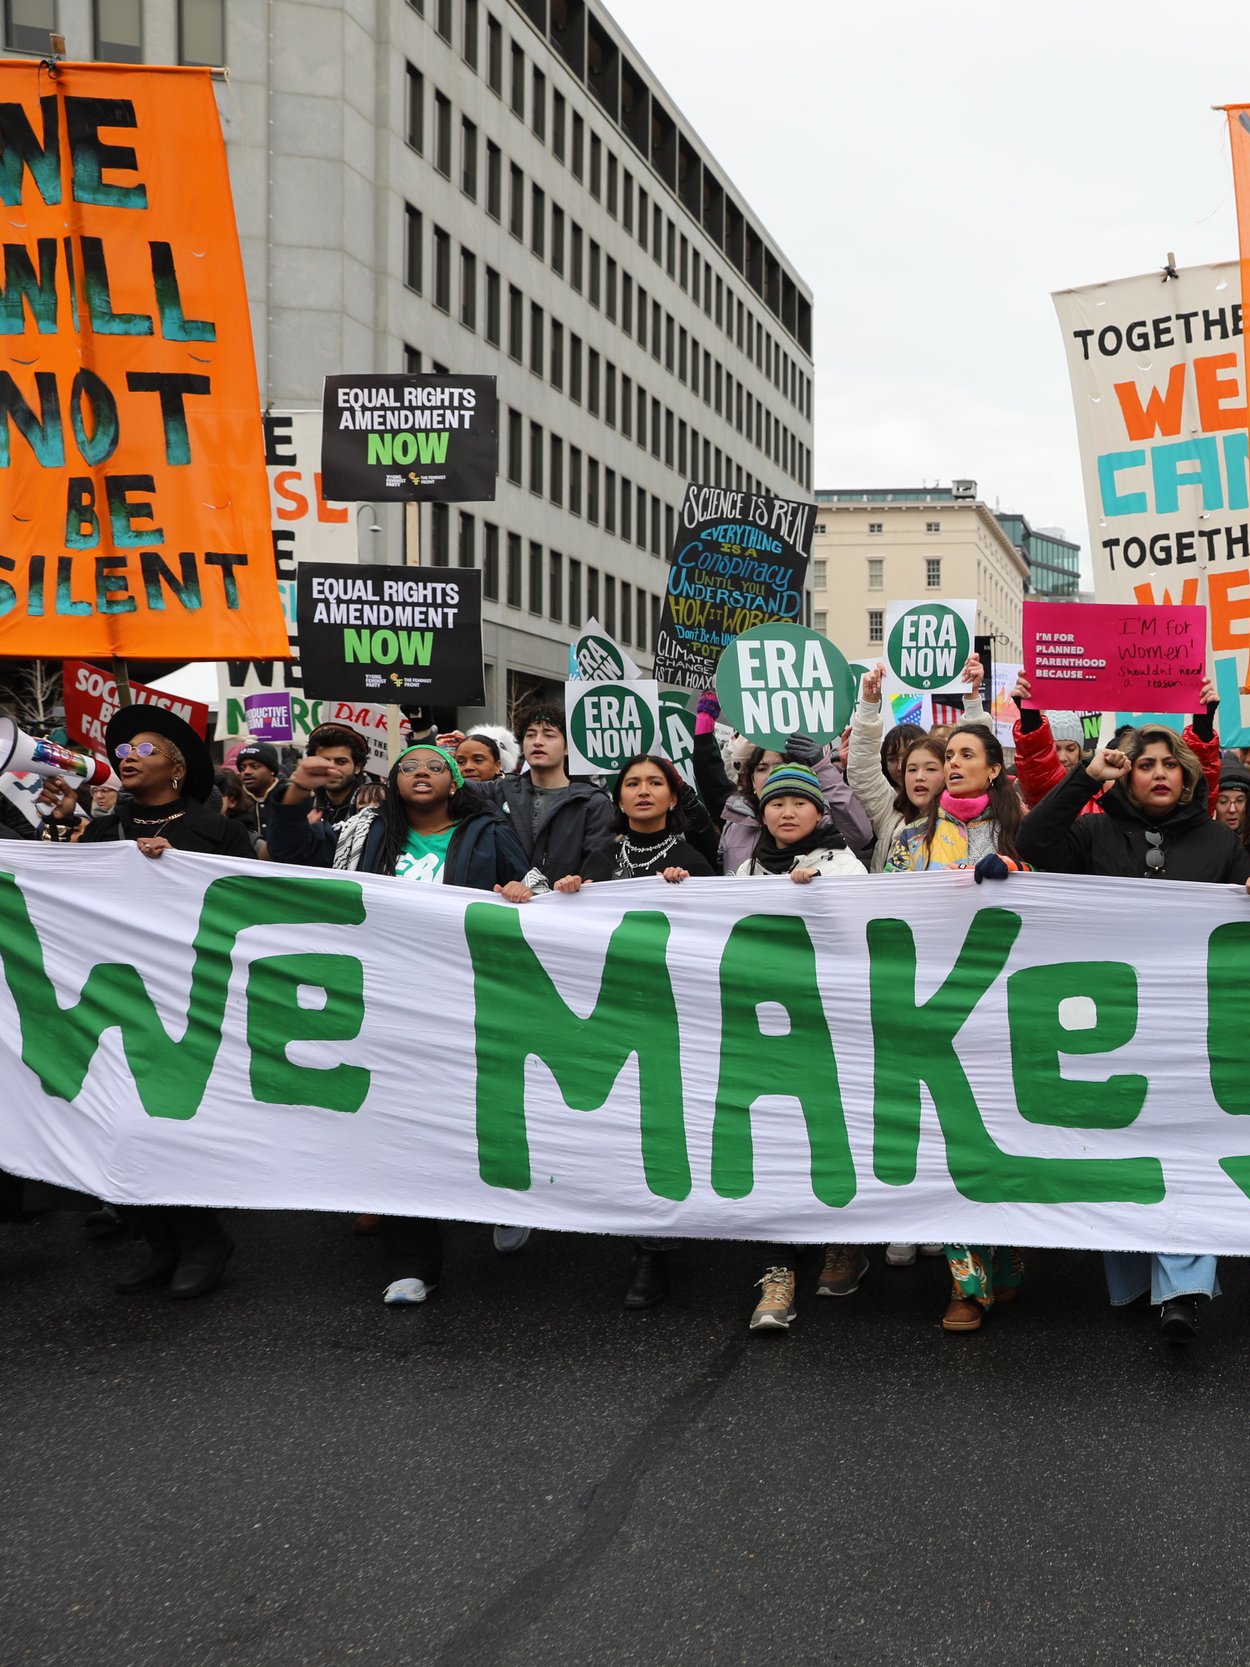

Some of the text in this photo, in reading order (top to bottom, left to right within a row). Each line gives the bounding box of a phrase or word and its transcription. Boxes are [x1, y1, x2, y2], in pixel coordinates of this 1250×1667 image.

[1073, 303, 1244, 360] TOGETHE
[337, 387, 476, 411] EQUAL RIGHTS
[1113, 352, 1248, 441] WE
[0, 367, 211, 467] NOT
[339, 409, 475, 430] AMENDMENT
[367, 431, 449, 465] NOW
[65, 474, 164, 549] BE
[684, 486, 809, 558] SCIENCE IS REAL
[700, 524, 782, 554] EVERYTHING
[720, 543, 757, 557] IS A
[1102, 523, 1249, 571] TOGETH
[312, 577, 459, 605] EQUAL RIGHTS
[668, 566, 800, 618] UNDERSTAND
[694, 570, 765, 596] UNTIL YOU
[314, 602, 458, 629] AMENDMENT
[668, 595, 711, 627] HOW
[710, 608, 723, 620] IT
[902, 614, 957, 647] ERA
[1036, 633, 1074, 642] I'M FOR
[344, 628, 434, 666] NOW
[657, 631, 714, 666] CLIMATE
[1036, 645, 1084, 654] PLANNED
[589, 656, 622, 681] OW
[656, 657, 714, 676] CHANGE
[736, 640, 833, 688] ERA
[900, 648, 957, 677] NOW
[1036, 658, 1106, 667] PARENTHOOD
[1036, 670, 1083, 679] BECAUSE
[685, 672, 712, 690] HOAX
[271, 718, 289, 728] ALL
[583, 696, 641, 728] ERA
[741, 691, 834, 734] NOW
[586, 730, 642, 758] NOW
